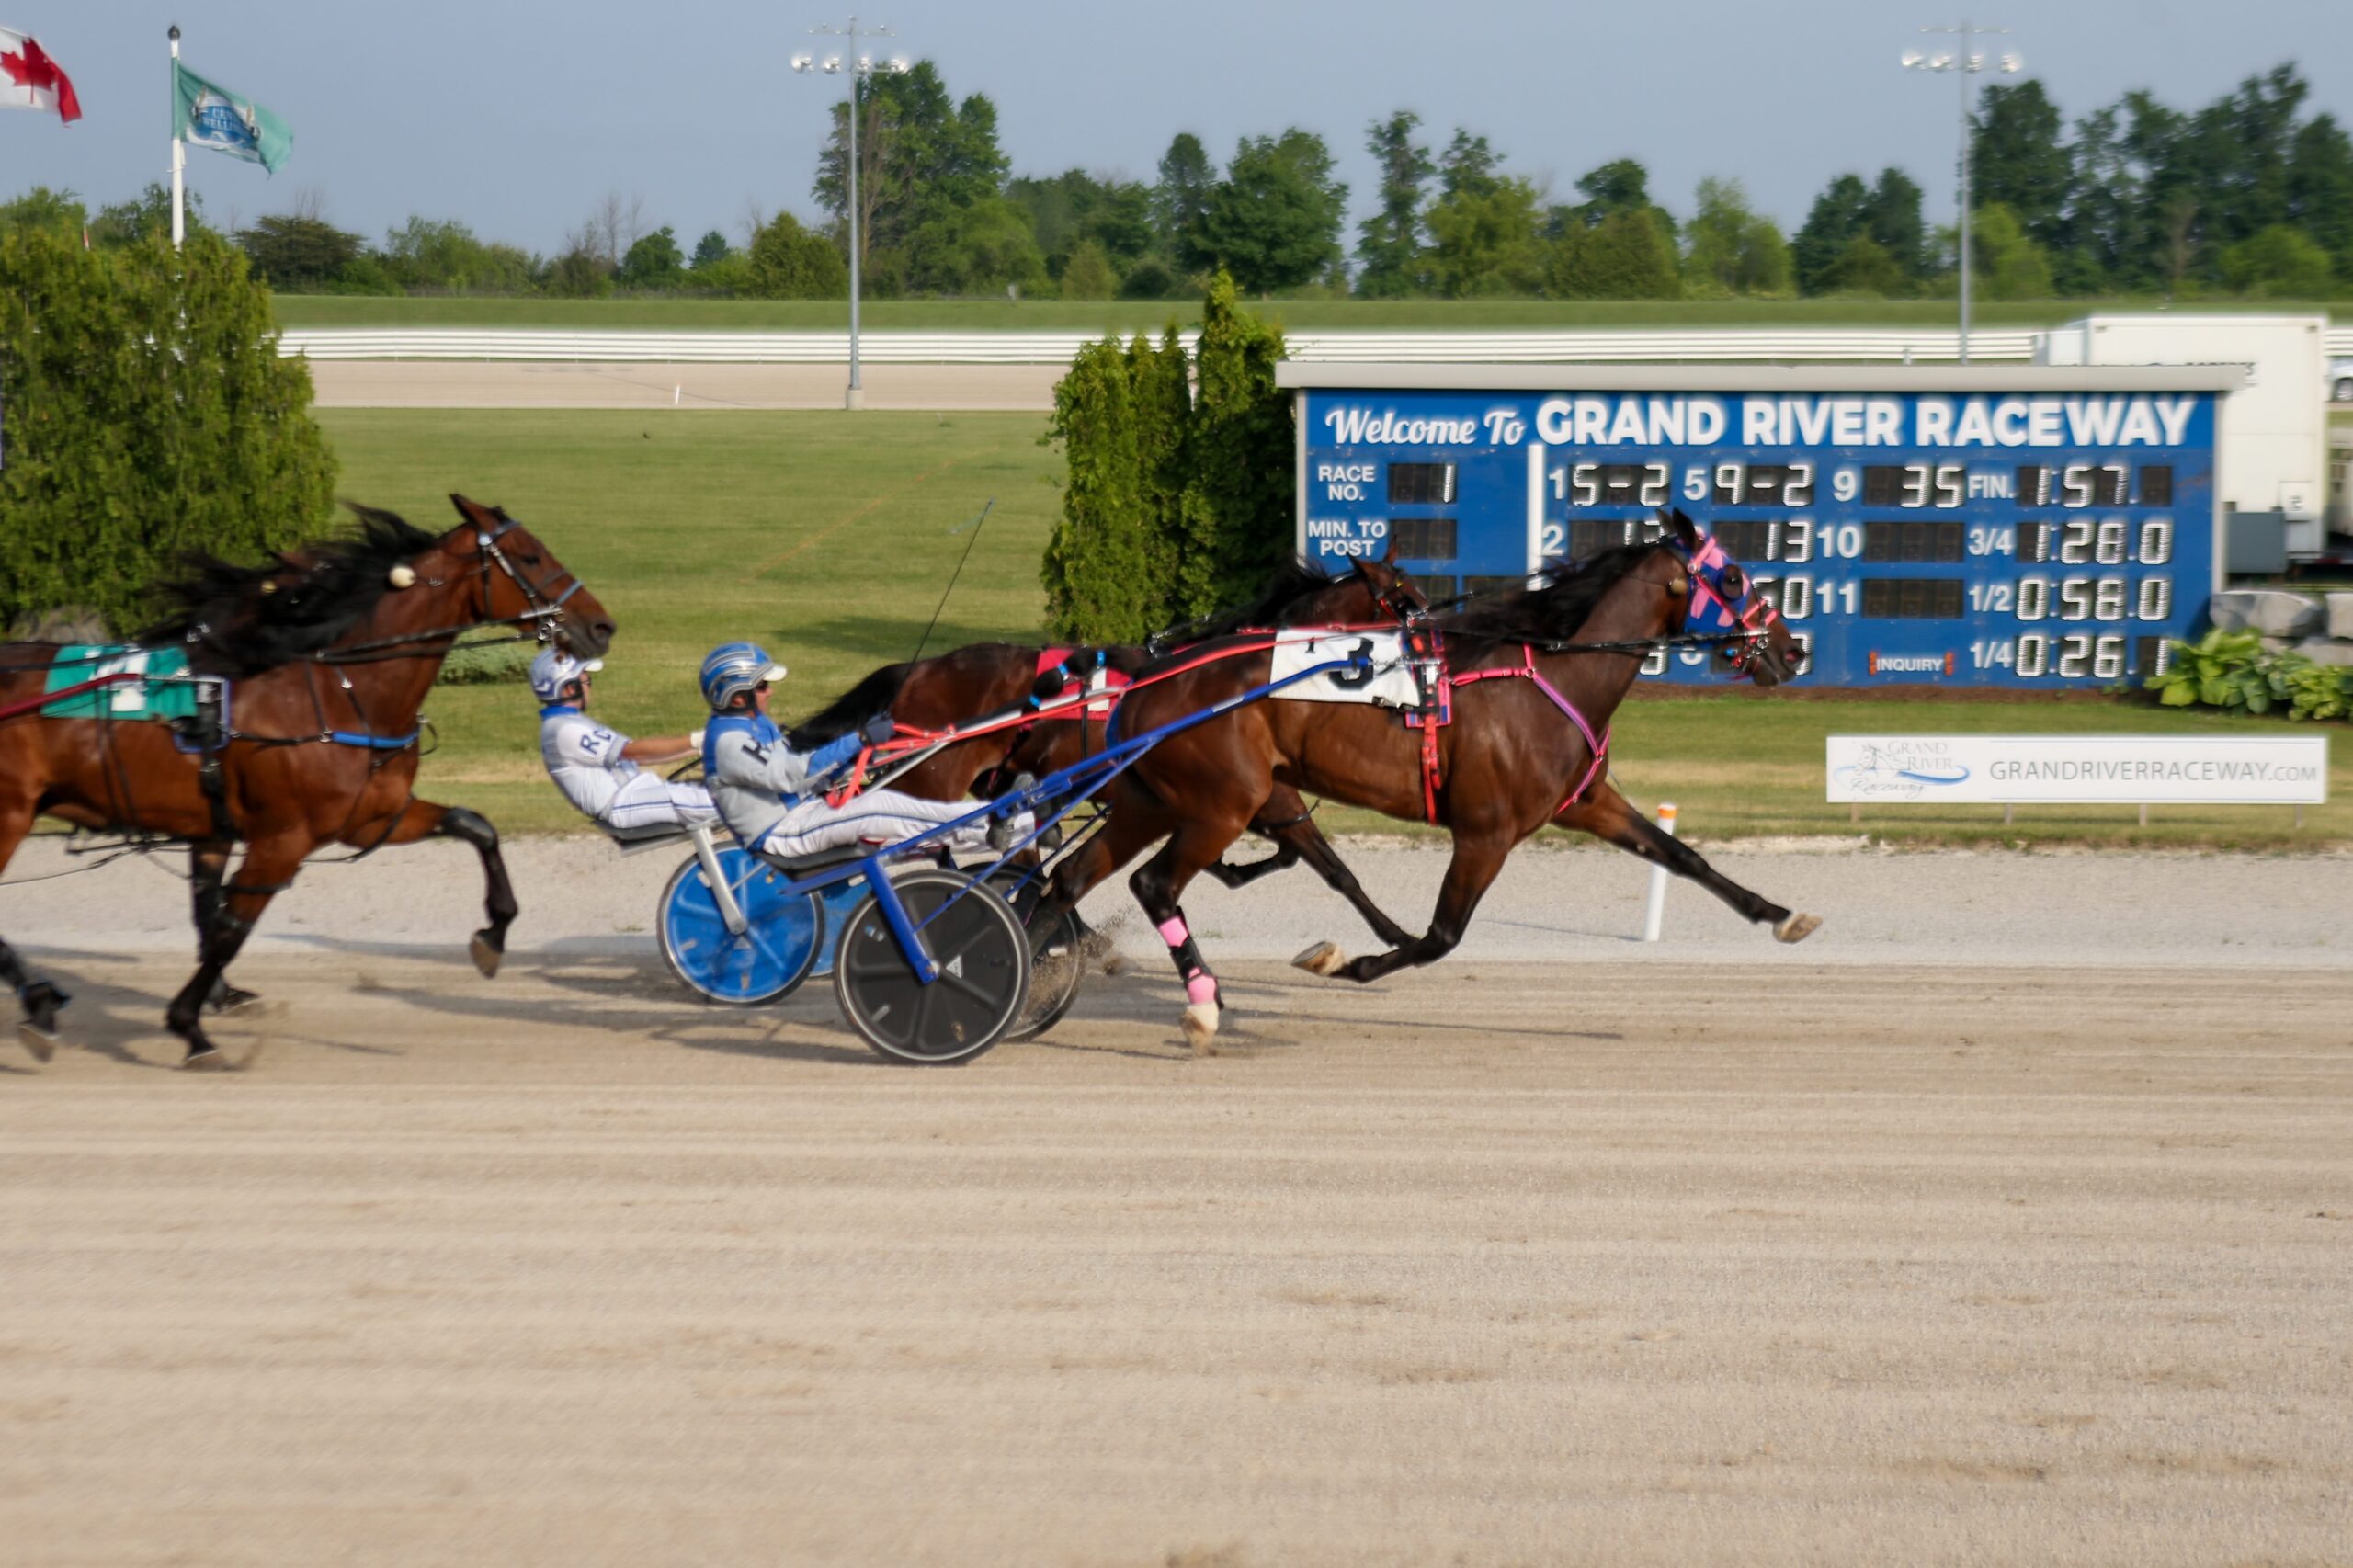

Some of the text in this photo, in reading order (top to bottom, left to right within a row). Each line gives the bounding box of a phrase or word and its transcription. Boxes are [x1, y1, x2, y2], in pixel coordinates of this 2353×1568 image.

[1325, 400, 2198, 448] Welcome To GRAND RIVER RACEWAY
[1318, 466, 1375, 483] RACE
[1443, 464, 1453, 503] 1
[1549, 468, 1563, 500] 1
[1684, 469, 1707, 501] 5
[1834, 471, 1857, 502] 9
[1901, 465, 1964, 508] 35
[1969, 475, 2015, 498] FIN.
[1328, 485, 1365, 501] NO.
[1308, 521, 1386, 538] MIN. TO
[1542, 525, 1564, 557] 2
[1767, 521, 1812, 563] 13
[1818, 526, 1861, 559] 10
[1969, 530, 2011, 555] 3/4
[1320, 540, 1375, 556] POST
[1816, 583, 1858, 614] 11
[1969, 587, 2011, 611] 1/2
[1328, 637, 1375, 691] 3
[1876, 658, 1944, 674] INQUIRY
[1970, 643, 2011, 668] 1/4
[1887, 741, 1949, 755] GRAND
[1906, 756, 1955, 770] RIVER
